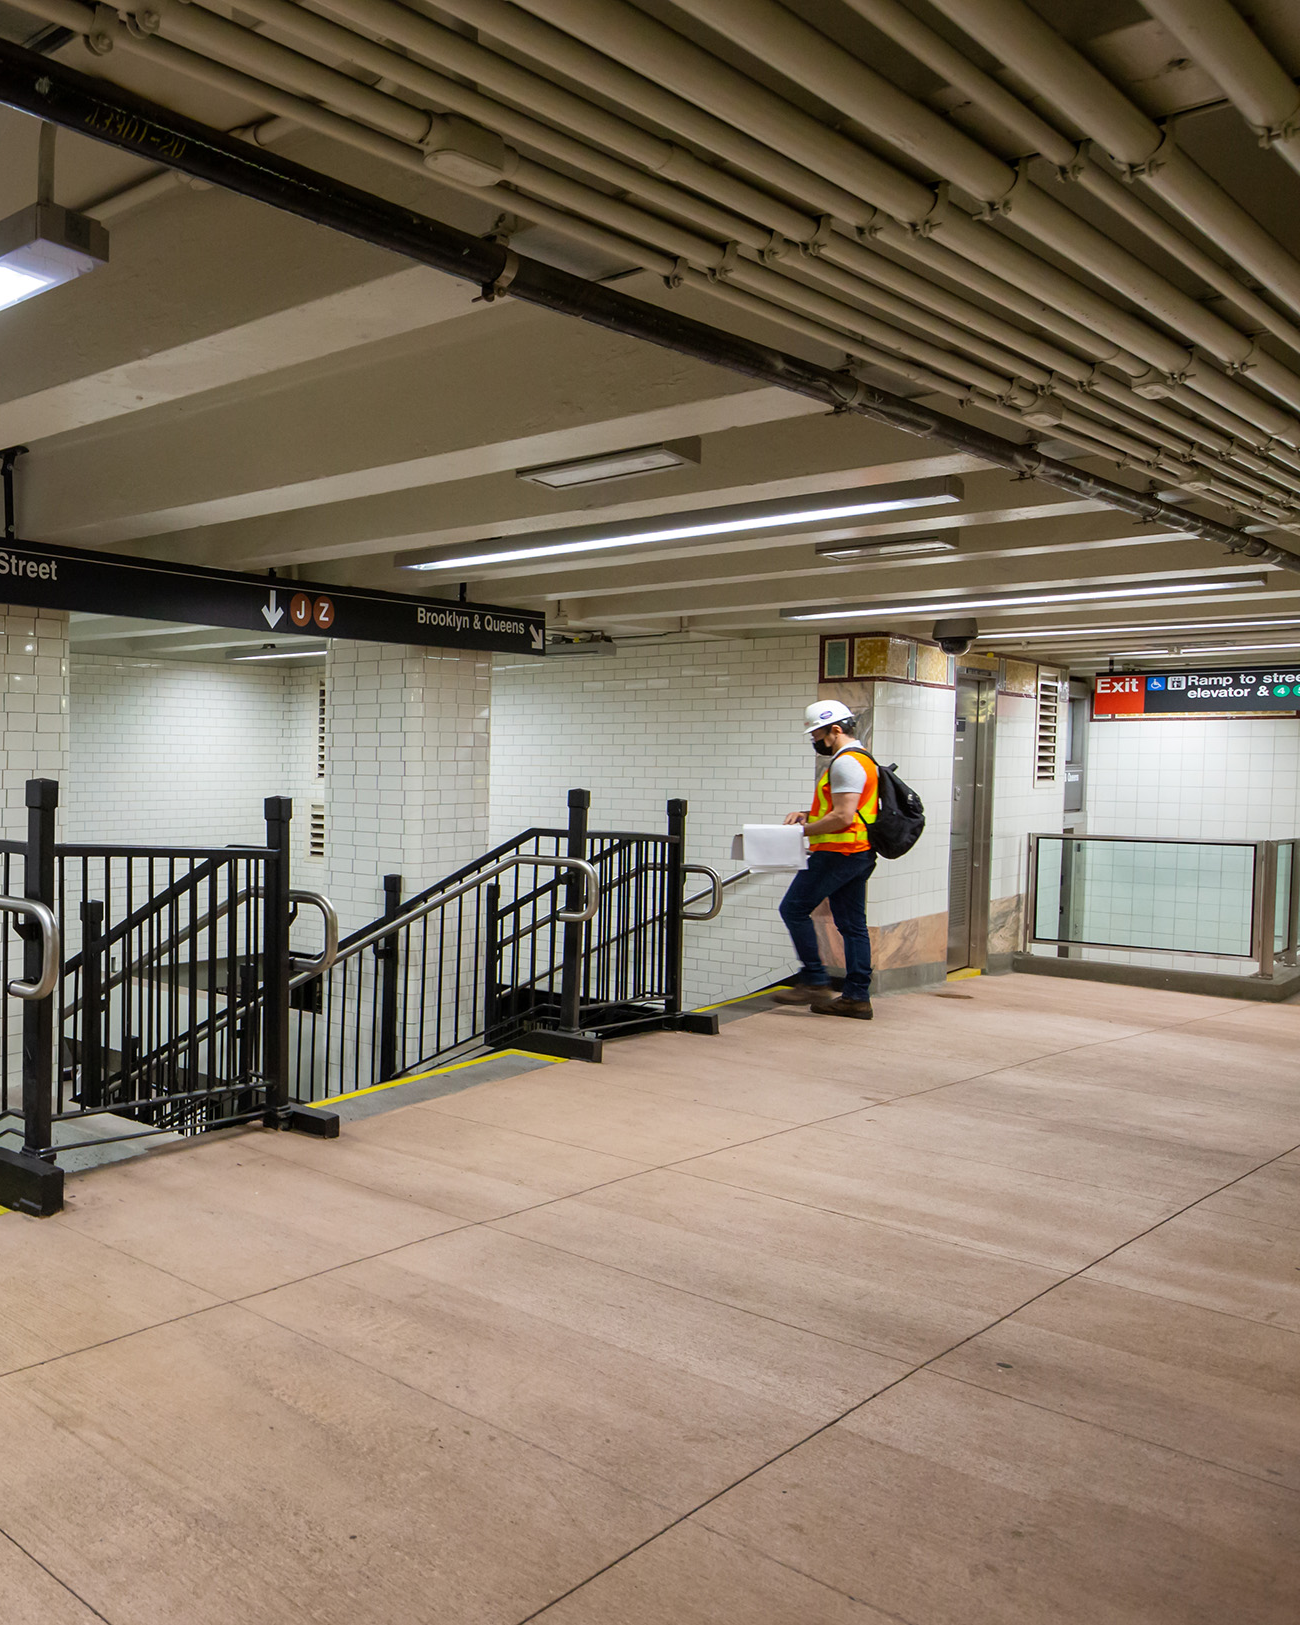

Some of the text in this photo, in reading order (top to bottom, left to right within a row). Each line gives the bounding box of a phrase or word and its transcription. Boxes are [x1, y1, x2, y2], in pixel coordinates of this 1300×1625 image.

[296, 600, 329, 621] J Z
[417, 607, 525, 635] Brooklyn & Queens
[1096, 678, 1139, 694] Exit
[1187, 675, 1233, 687] Ramp
[1239, 674, 1256, 684] to
[1187, 687, 1251, 699] elevator
[1256, 685, 1270, 697] &
